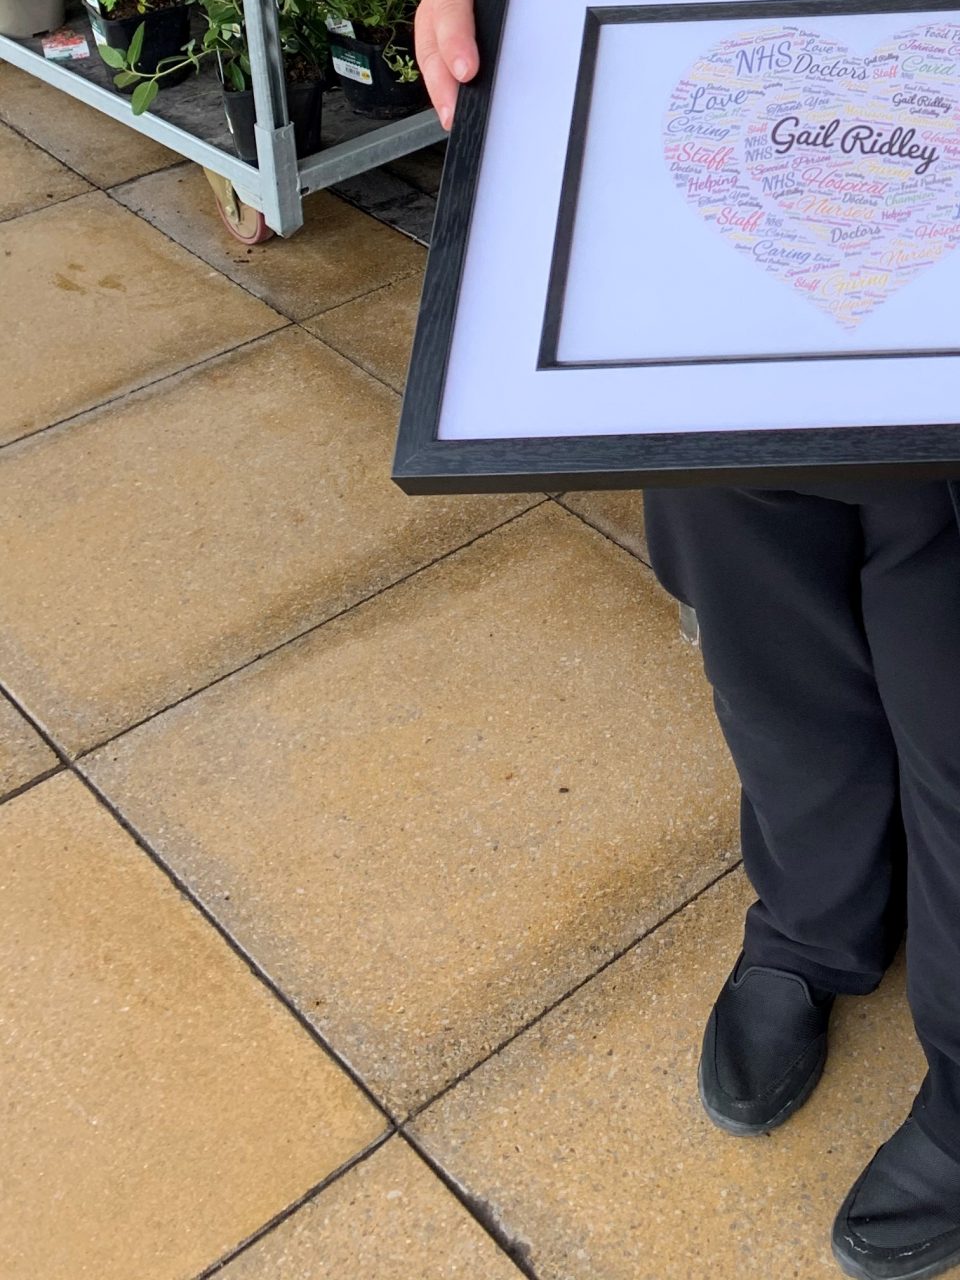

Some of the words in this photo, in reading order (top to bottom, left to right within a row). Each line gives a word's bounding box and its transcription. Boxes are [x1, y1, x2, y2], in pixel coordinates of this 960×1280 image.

[736, 40, 792, 76] NHS
[800, 38, 833, 53] Love
[793, 53, 871, 81] Doctors
[684, 86, 748, 115] Love
[892, 92, 918, 107] Gail
[916, 95, 953, 114] Ridley
[667, 116, 730, 141] Caring
[677, 142, 735, 171] Staff
[745, 146, 773, 163] NHS
[771, 114, 835, 154] Gail
[840, 125, 941, 175] Ridley
[687, 174, 739, 193] Helping
[761, 171, 796, 192] NHS
[801, 166, 890, 196] Hospital
[716, 206, 766, 232] Staff
[830, 224, 882, 244] Doctors
[752, 239, 812, 265] Caring
